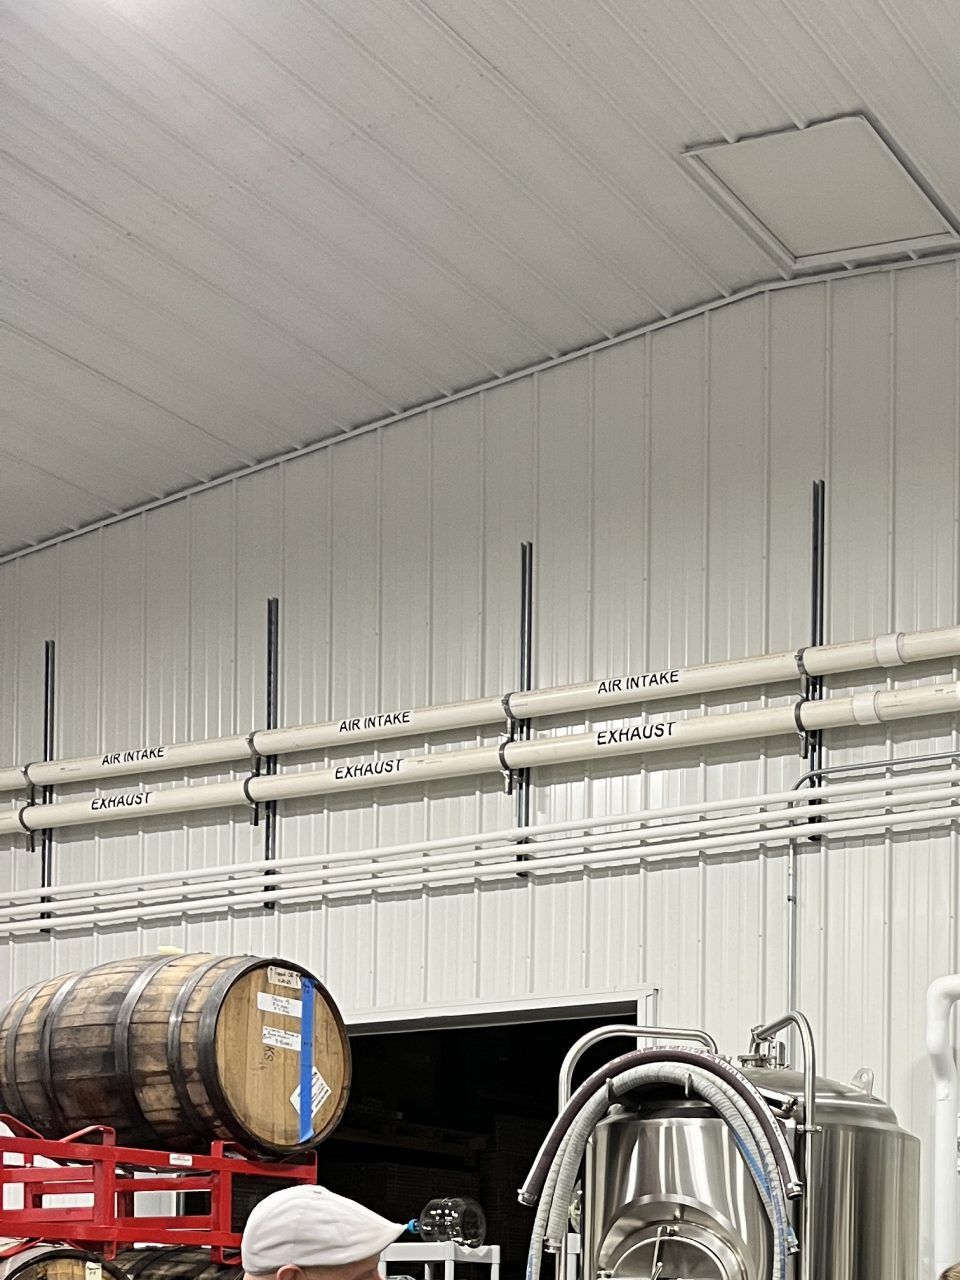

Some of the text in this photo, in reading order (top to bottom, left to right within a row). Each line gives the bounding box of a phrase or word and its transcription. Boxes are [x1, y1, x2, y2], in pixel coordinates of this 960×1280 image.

[597, 669, 679, 694] AIR INTAKE
[339, 711, 410, 733] AIR INTAKE
[597, 721, 677, 746] EXHAUST
[101, 747, 164, 766] AIR INTAKE
[335, 758, 405, 781] EXHAUST
[91, 791, 152, 811] EXHAUST
